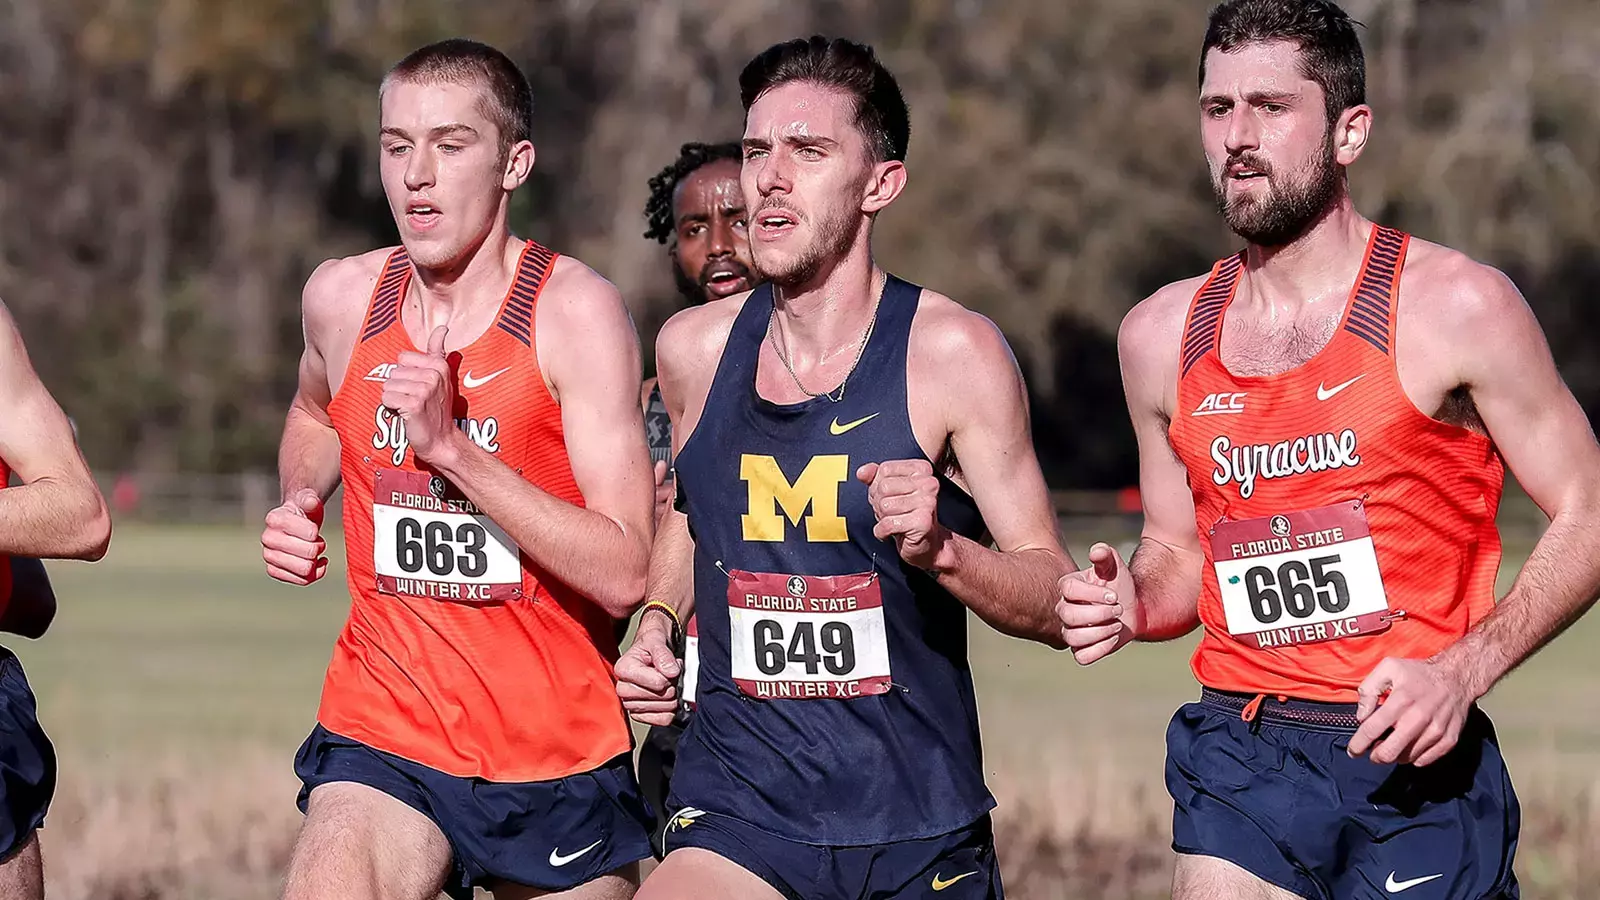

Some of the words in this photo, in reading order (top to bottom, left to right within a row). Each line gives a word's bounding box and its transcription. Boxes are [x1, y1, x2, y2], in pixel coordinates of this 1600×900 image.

[1195, 392, 1248, 411] ACC
[1210, 428, 1361, 499] Syracuse
[391, 491, 443, 512] FLORIDA
[739, 453, 850, 542] M
[396, 517, 488, 578] 663
[1231, 536, 1292, 558] FLORIDA
[1295, 527, 1344, 549] STATE
[395, 578, 461, 599] WINTER
[466, 584, 491, 600] XC
[745, 594, 805, 611] FLORIDA
[809, 596, 857, 611] STATE
[1244, 554, 1350, 624] 665
[753, 619, 856, 676] 649
[1255, 622, 1328, 648] WINTER
[1332, 618, 1360, 637] XC
[755, 681, 829, 697] WINTER
[835, 680, 861, 697] XC
